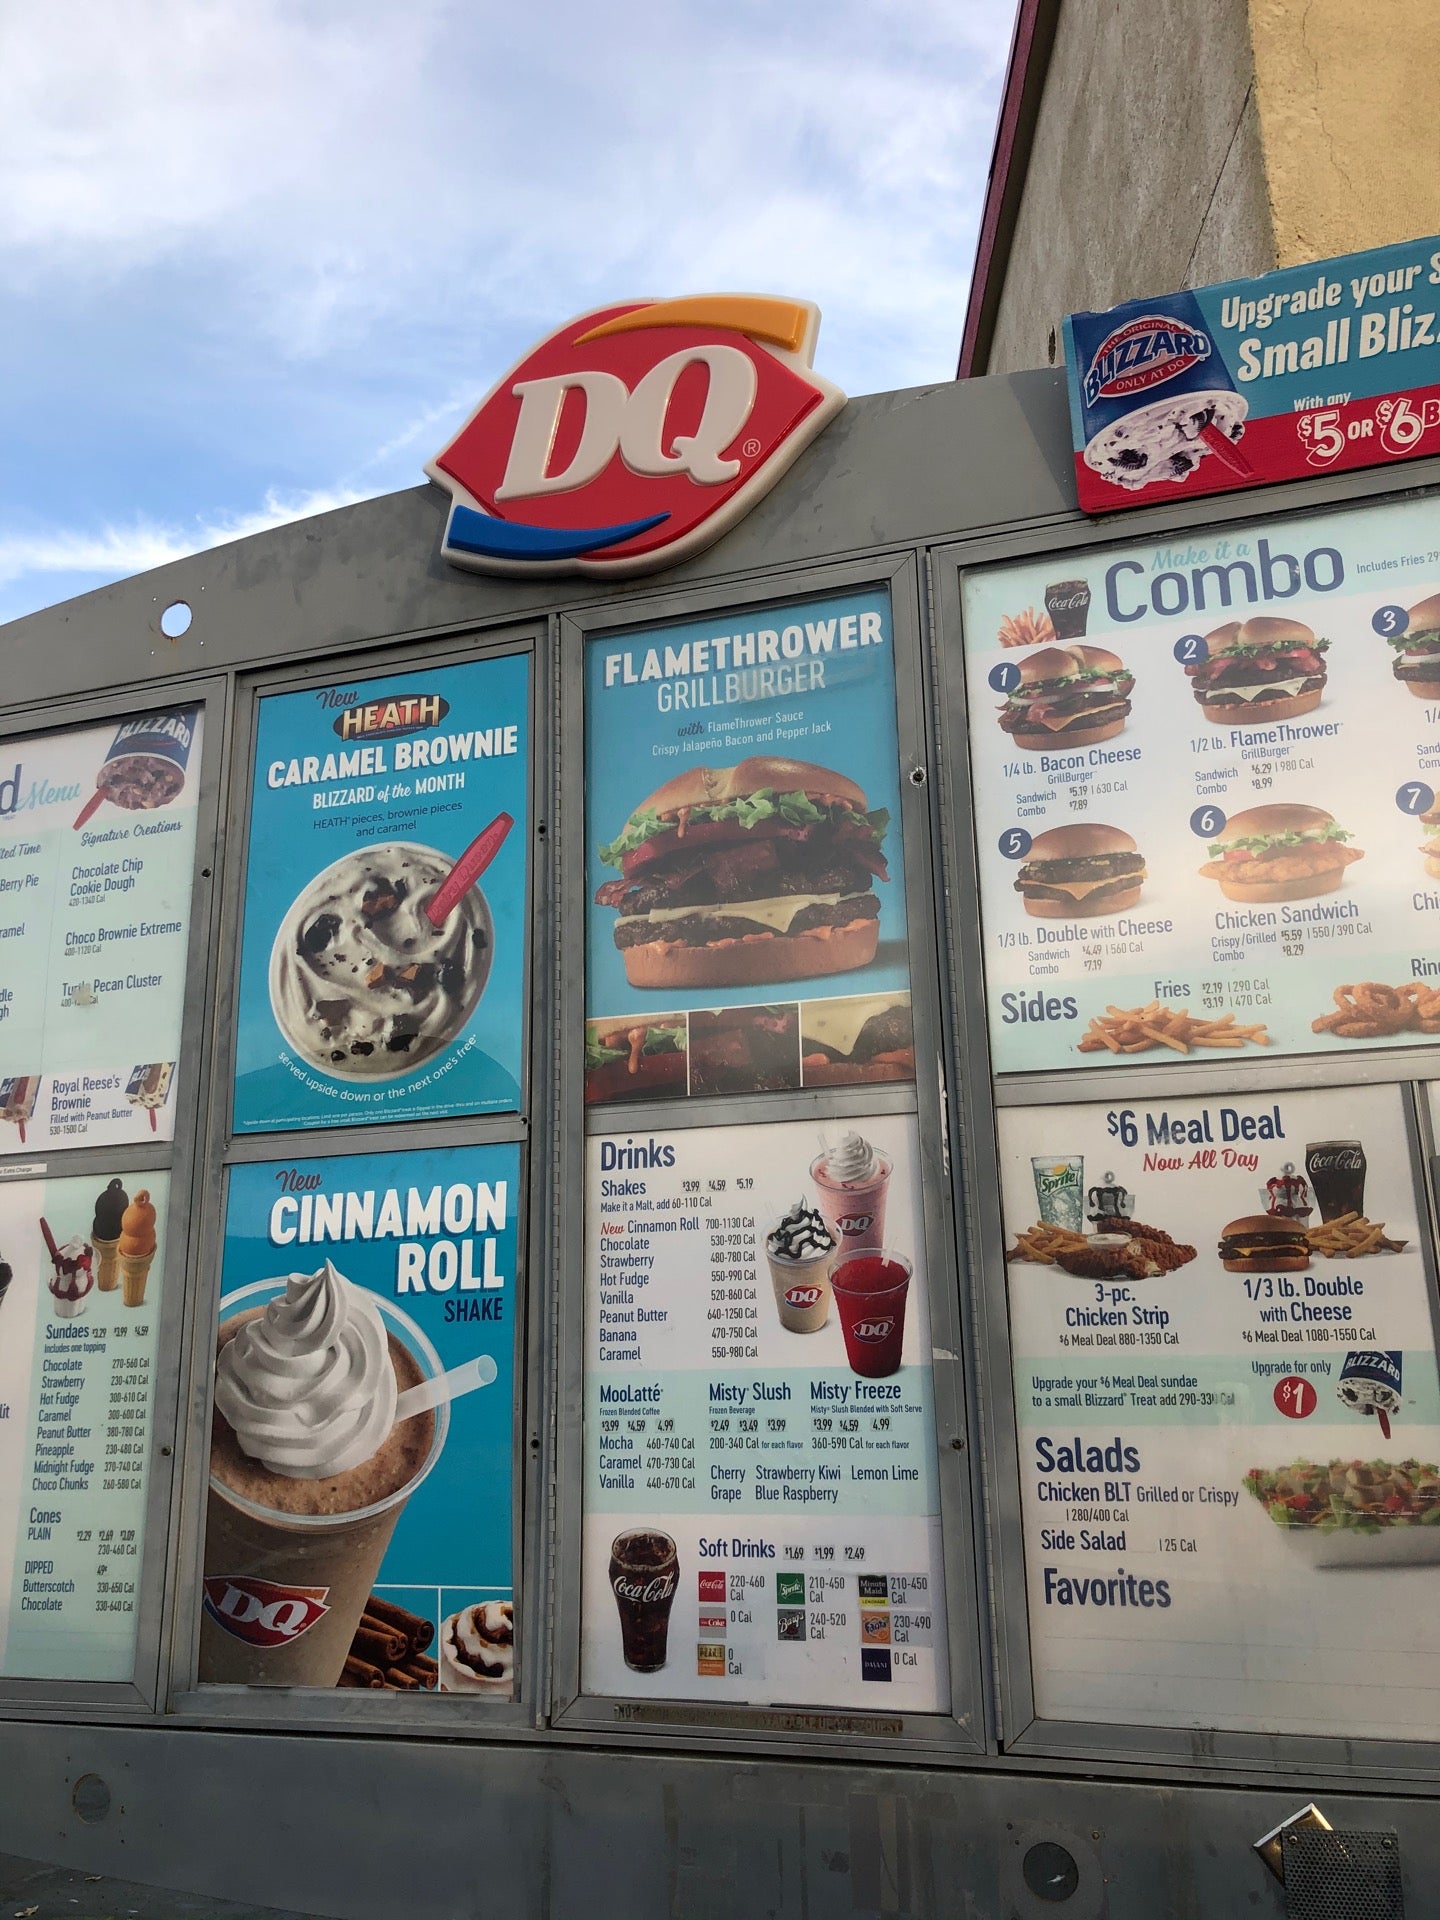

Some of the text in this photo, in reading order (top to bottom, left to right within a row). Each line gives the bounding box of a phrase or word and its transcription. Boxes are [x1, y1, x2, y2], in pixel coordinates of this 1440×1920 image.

[1221, 264, 1423, 331] Upgrade your
[1103, 322, 1177, 353] THE ORIGINAL
[1237, 318, 1350, 382] Small
[1085, 331, 1209, 408] BLIZZARD
[1117, 375, 1147, 390] ONLY
[1151, 368, 1165, 383] AT
[1294, 392, 1351, 412] With any
[494, 345, 759, 503] DQ
[1298, 399, 1425, 466] $5 OR $6
[1151, 542, 1250, 571] Make it a
[1104, 539, 1345, 623] Combo
[1382, 611, 1396, 632] 3
[604, 611, 883, 687] FLAMETHROWER
[1182, 639, 1197, 667] 2
[657, 661, 825, 712] GRILLBURGER
[316, 688, 359, 710] New
[341, 694, 440, 741] HEATH
[678, 711, 803, 737] with FlameThrower Sauce
[652, 721, 832, 757] Crispy Jalapeño Bacon and Pepper Jack
[1191, 722, 1340, 753] 1/2 lb. FlameThrower
[267, 725, 518, 789] CARAMEL BROWNIE
[1003, 747, 1142, 778] 1/4 lb. Bacon Cheese
[16, 778, 81, 810] Menu
[312, 772, 465, 810] BLIZZARD of the MONTH
[313, 802, 462, 830] HEATH pieces, brownie pieces
[1200, 810, 1215, 832] 6
[81, 820, 183, 847] Signature Creations
[356, 820, 416, 838] and caramel
[1008, 832, 1021, 854] 5
[72, 858, 144, 880] Chocolate Chip
[70, 876, 135, 897] Cookie Dough
[1215, 900, 1359, 931] Chicken Sandwich
[65, 921, 182, 946] Choco Brownie Extreme
[93, 977, 124, 993] Pecan
[126, 974, 162, 988] Cluster
[1154, 979, 1191, 999] Fries
[1001, 990, 1079, 1024] Sides
[53, 1074, 120, 1094] Royal Reese's
[278, 1052, 304, 1080] served
[305, 1077, 339, 1098] upside
[340, 1090, 371, 1101] down
[373, 1092, 385, 1101] or
[388, 1088, 406, 1099] the
[408, 1076, 433, 1093] next
[433, 1058, 458, 1080] one's
[51, 1094, 91, 1111] Brownie
[50, 1108, 133, 1124] Filled with Peanut Butter
[1106, 1105, 1285, 1147] $6 Meal Deal
[600, 1138, 676, 1171] Drinks
[1143, 1149, 1259, 1172] Now All Day
[1309, 1149, 1362, 1174] Coca-Cola
[275, 1168, 323, 1192] New
[601, 1179, 646, 1196] Shakes
[1042, 1171, 1076, 1193] Sprite
[269, 1180, 507, 1246] CINNAMON
[600, 1218, 700, 1235] New Cinnamon Roll
[397, 1237, 505, 1294] ROLL
[600, 1291, 634, 1304] Vanilla
[1095, 1283, 1136, 1306] 3-pc.
[1243, 1276, 1364, 1301] 1/3 lb. Double
[444, 1297, 503, 1322] SHAKE
[1065, 1305, 1169, 1329] Chicken Strip
[1259, 1302, 1352, 1322] with Cheese
[46, 1323, 89, 1339] Sundaes
[600, 1328, 637, 1342] Banana
[43, 1359, 82, 1372] Chocolate
[599, 1347, 641, 1361] Caramel
[1252, 1360, 1331, 1376] Upgrade for only
[1345, 1354, 1400, 1381] BLIZZARD
[42, 1376, 85, 1390] Strawberry
[600, 1383, 661, 1402] MooLatté
[709, 1382, 791, 1405] Misty Slush
[810, 1381, 901, 1403] Misty Freeze
[1282, 1381, 1304, 1414] $1
[35, 1443, 74, 1458] Pineapple
[1035, 1437, 1140, 1473] Salads
[711, 1465, 841, 1483] Cherry Strawberry Kiwi
[851, 1465, 919, 1480] Lemon Lime
[1038, 1482, 1239, 1507] Chicken BLT Grilled or Crispy
[30, 1507, 62, 1524] Cones
[699, 1538, 775, 1558] Soft Drinks
[1041, 1530, 1126, 1551] Side Salad
[25, 1561, 53, 1574] DIPPED
[23, 1579, 74, 1593] Butterscotch
[613, 1571, 674, 1603] Coca-Cola
[1043, 1568, 1171, 1608] Favorites
[217, 1582, 308, 1636] DQ
